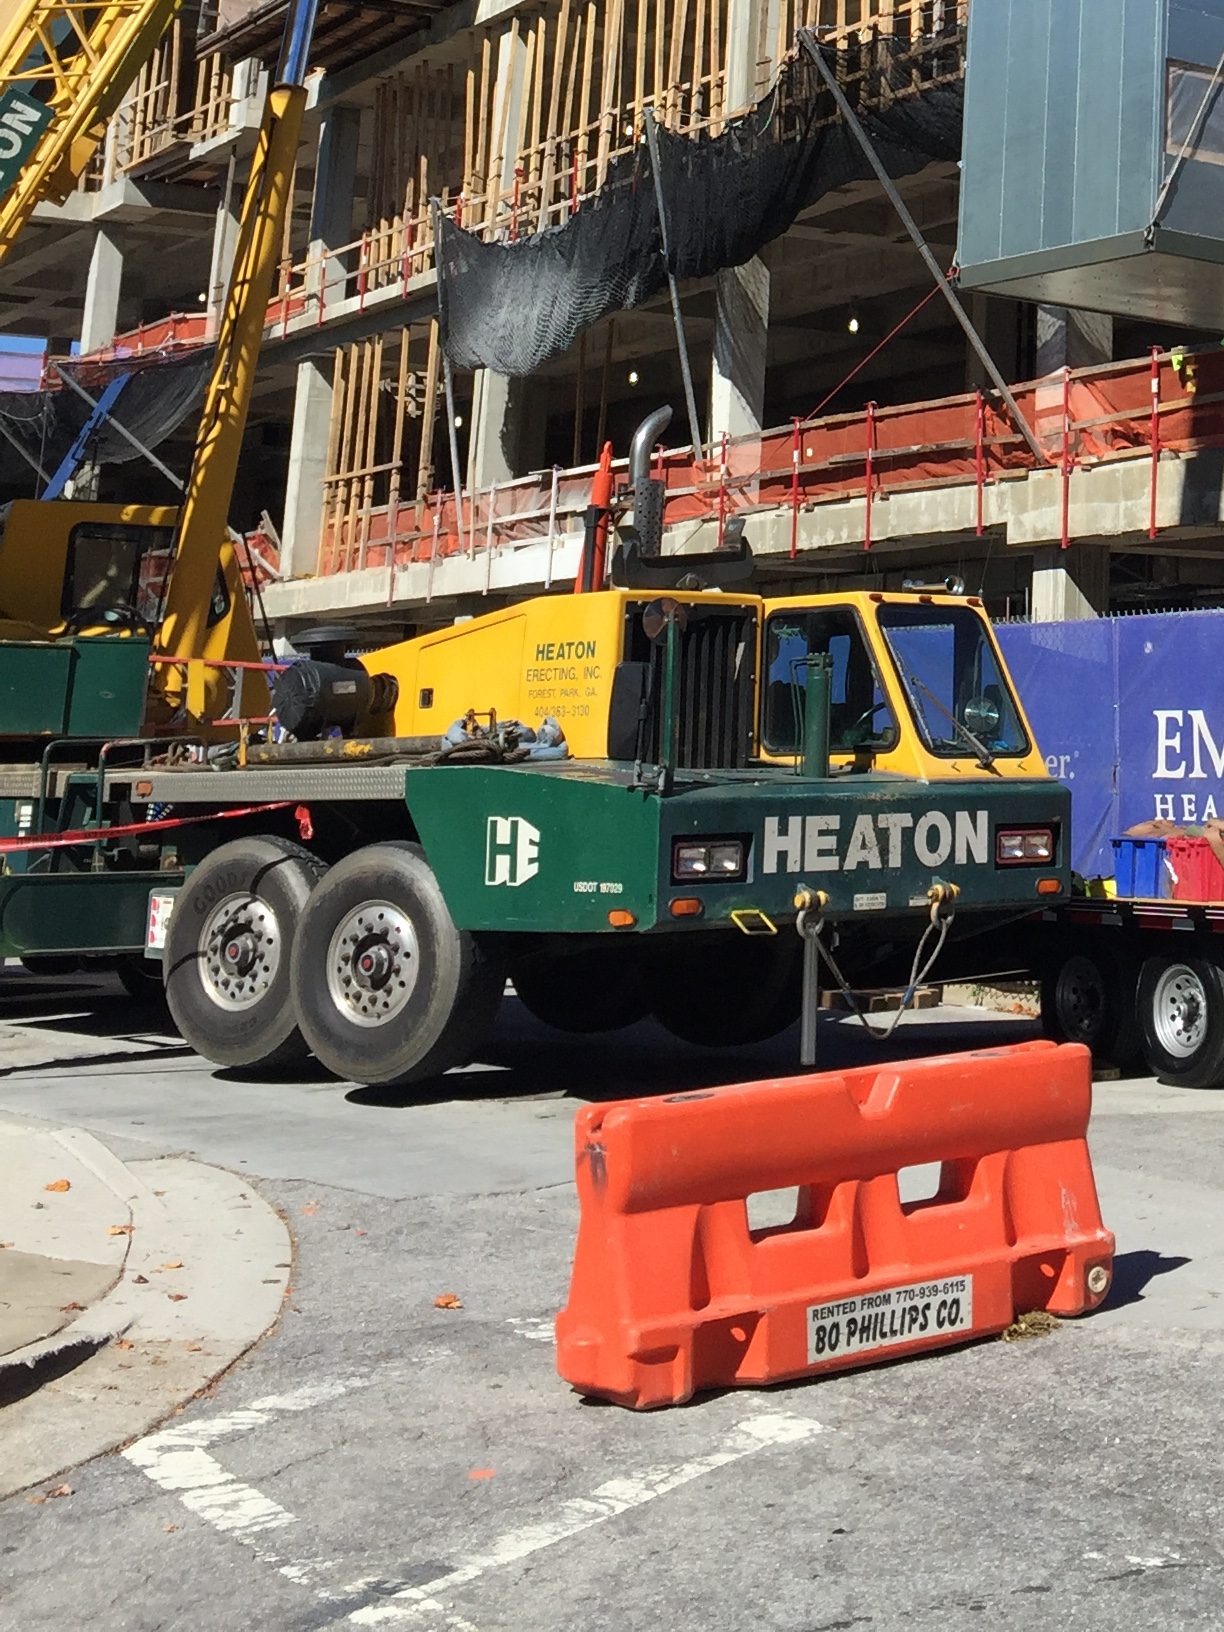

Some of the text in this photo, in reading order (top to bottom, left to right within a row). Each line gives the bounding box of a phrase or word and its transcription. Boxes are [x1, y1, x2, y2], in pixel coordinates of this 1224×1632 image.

[0, 99, 42, 181] ON
[526, 667, 578, 683] ERECTING,
[535, 640, 597, 662] HEATON
[762, 810, 989, 874] HEATON
[812, 1279, 966, 1322] RENTED FROM 770-939-6115
[814, 1297, 964, 1355] BO PHILLIPS CO.
